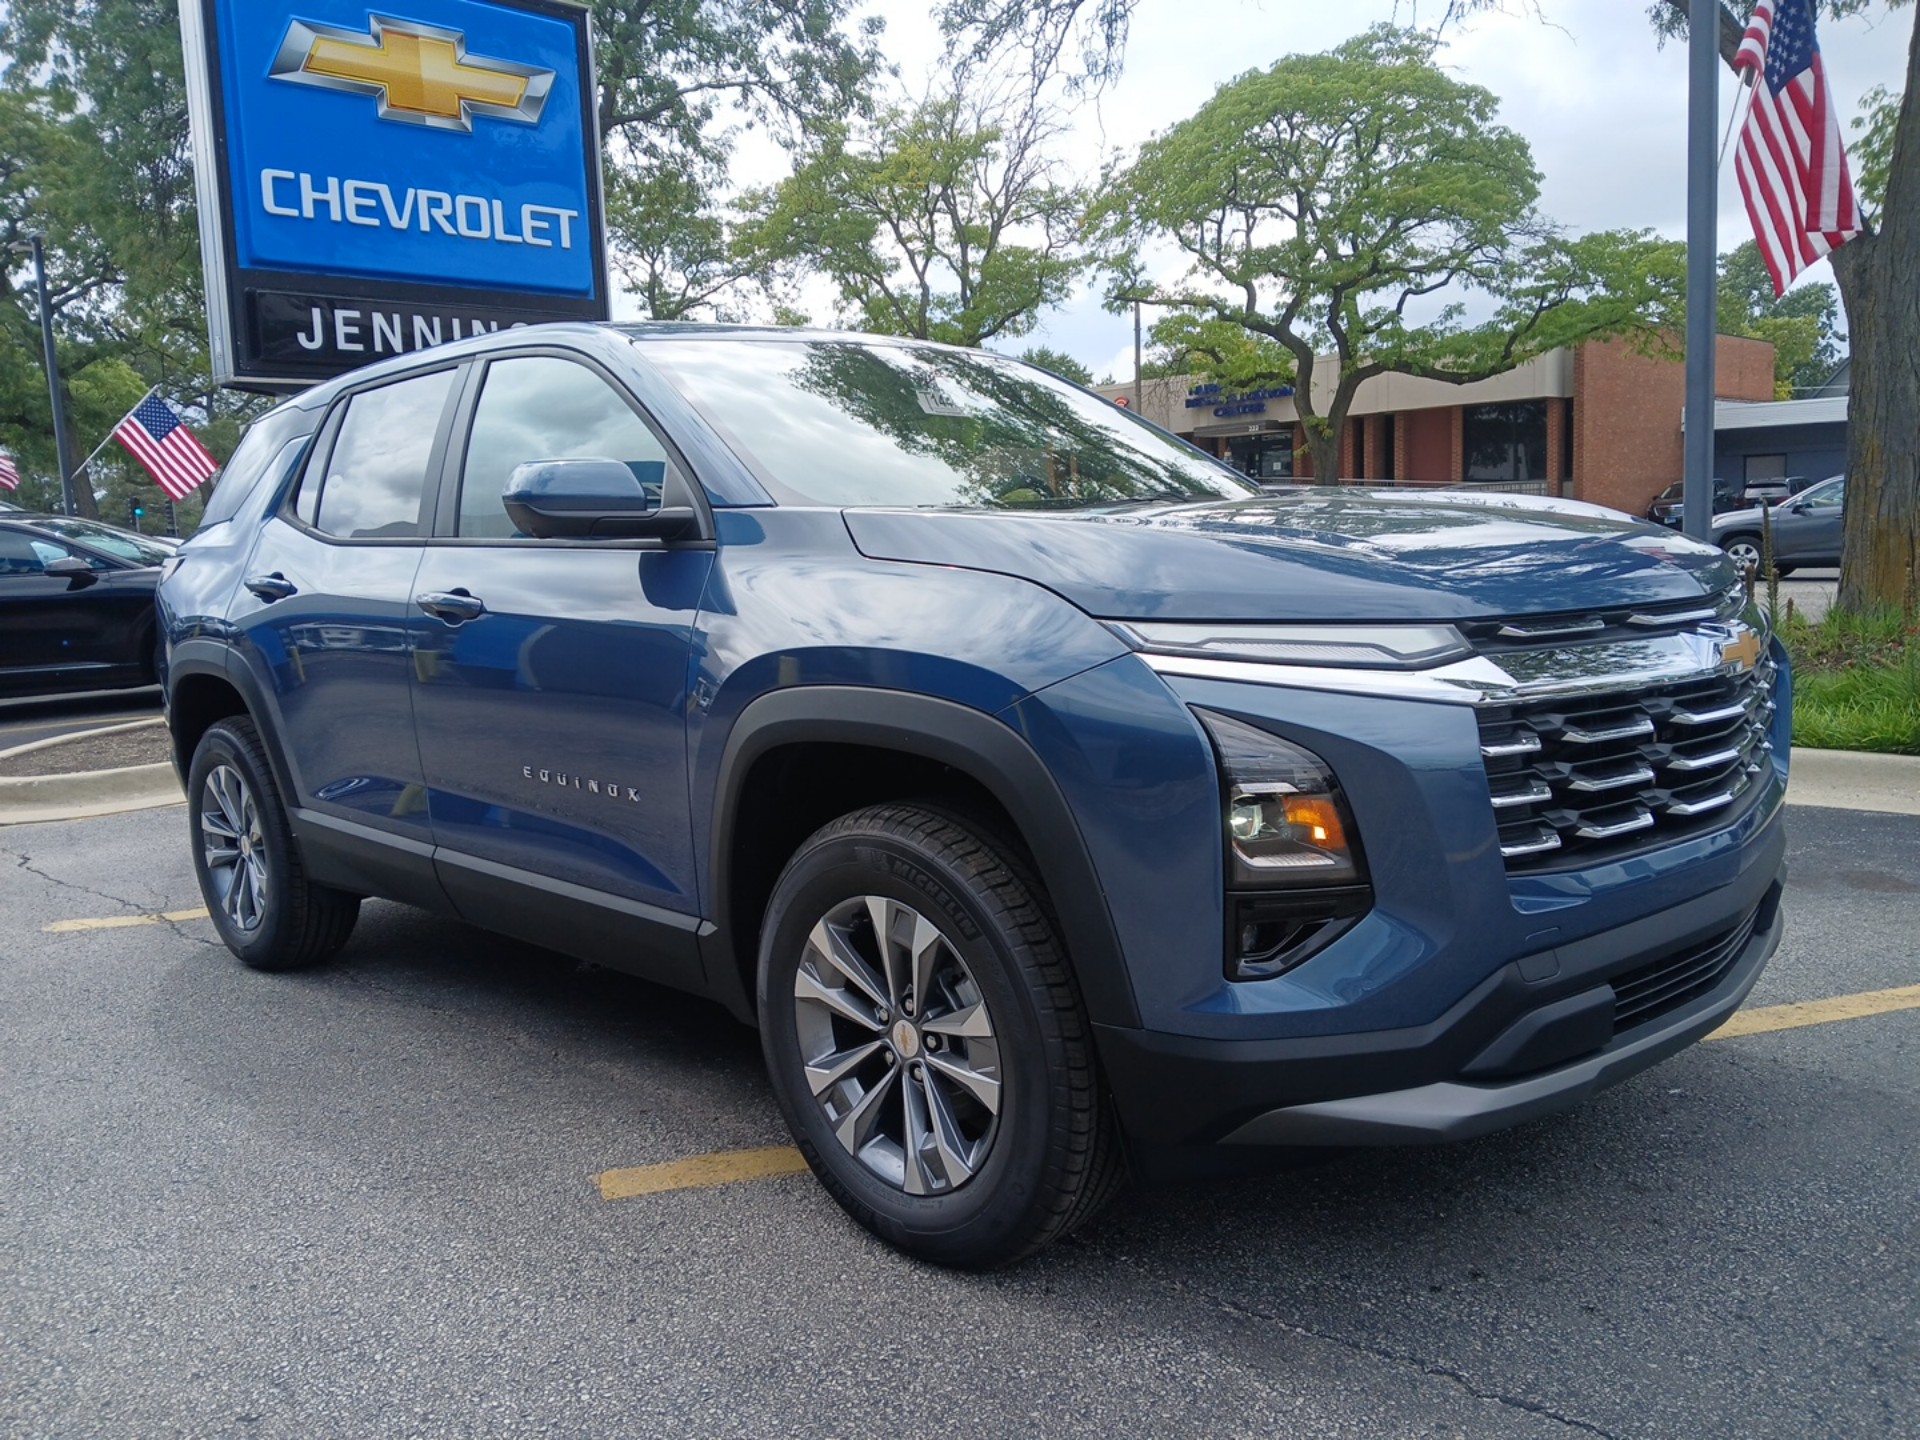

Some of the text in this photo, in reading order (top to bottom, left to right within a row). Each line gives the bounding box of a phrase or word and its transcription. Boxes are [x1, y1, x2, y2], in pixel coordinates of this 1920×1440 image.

[260, 168, 579, 249] CHEVROLET
[296, 307, 529, 354] JENNI
[523, 766, 641, 802] EQUINOX
[892, 860, 978, 938] MICHELIN
